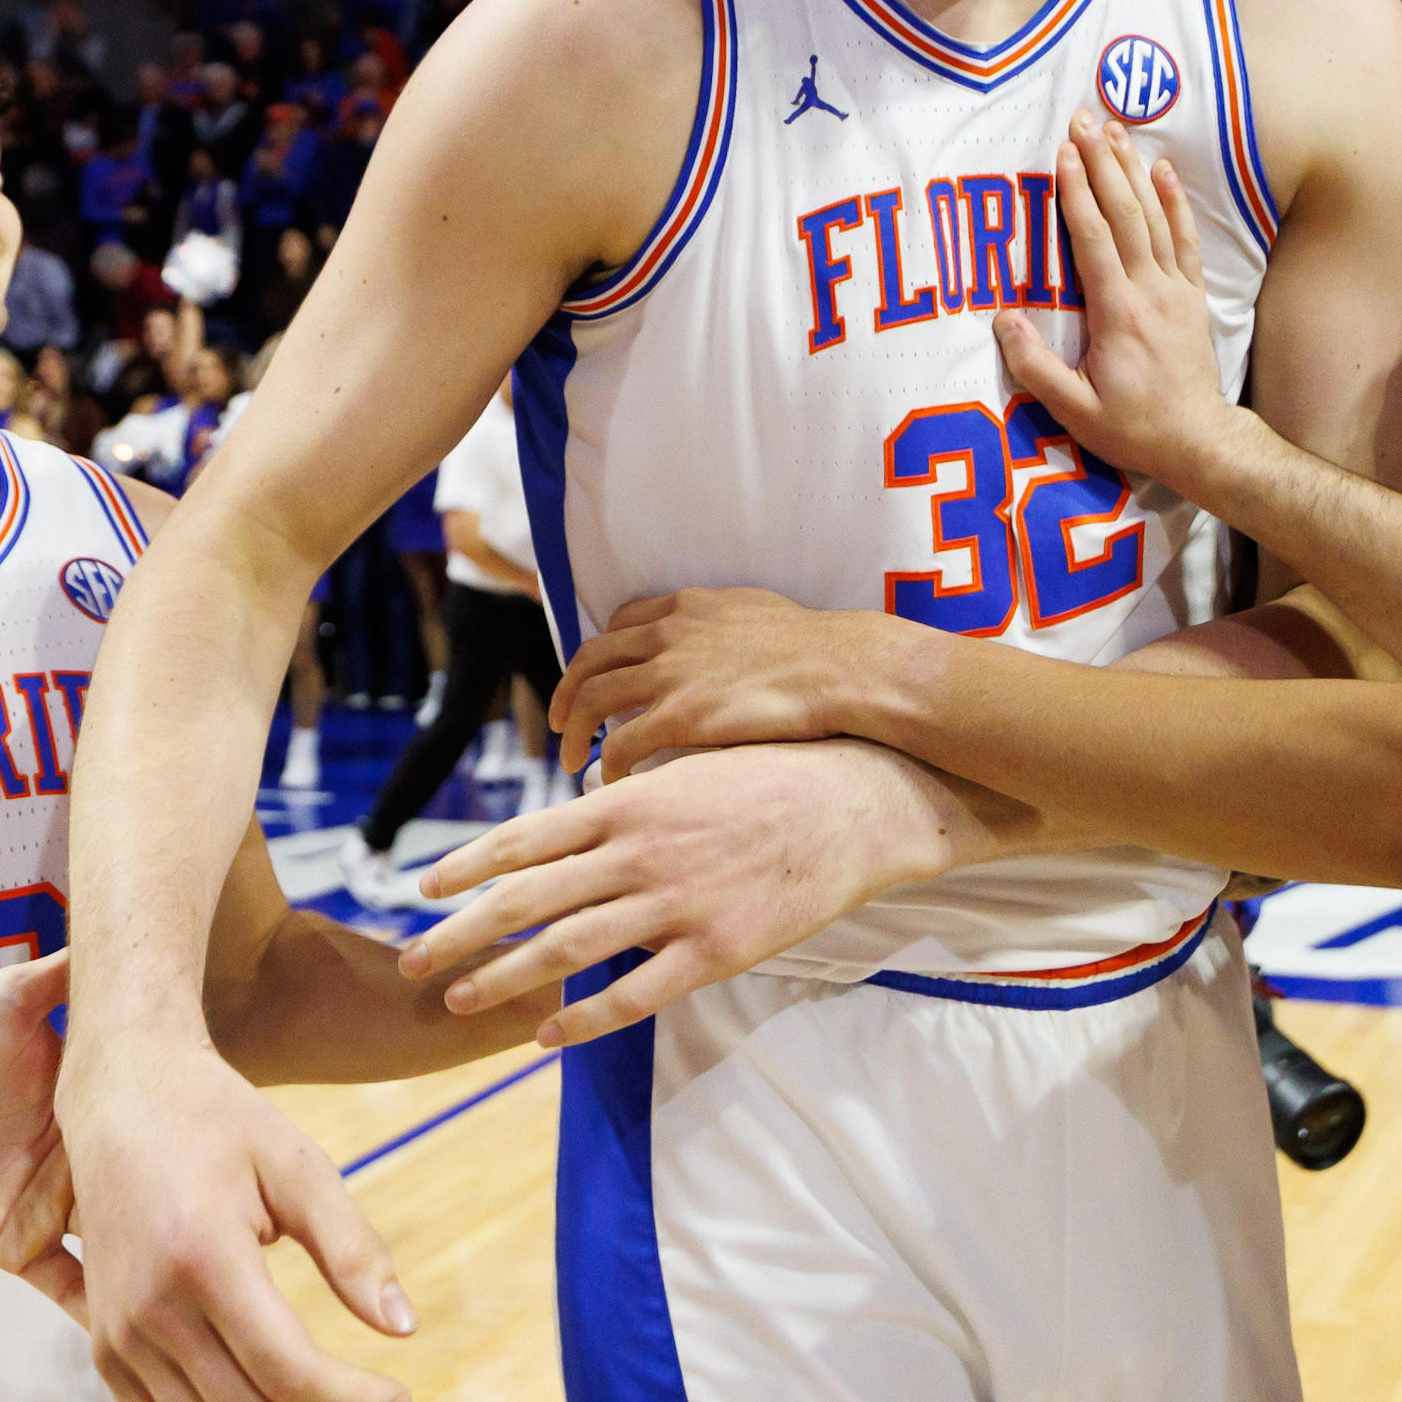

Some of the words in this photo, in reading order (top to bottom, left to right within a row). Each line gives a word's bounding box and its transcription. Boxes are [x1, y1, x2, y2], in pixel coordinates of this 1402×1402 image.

[1104, 38, 1174, 117] SEC
[798, 172, 1085, 355] FLORI
[884, 393, 1145, 637] 32
